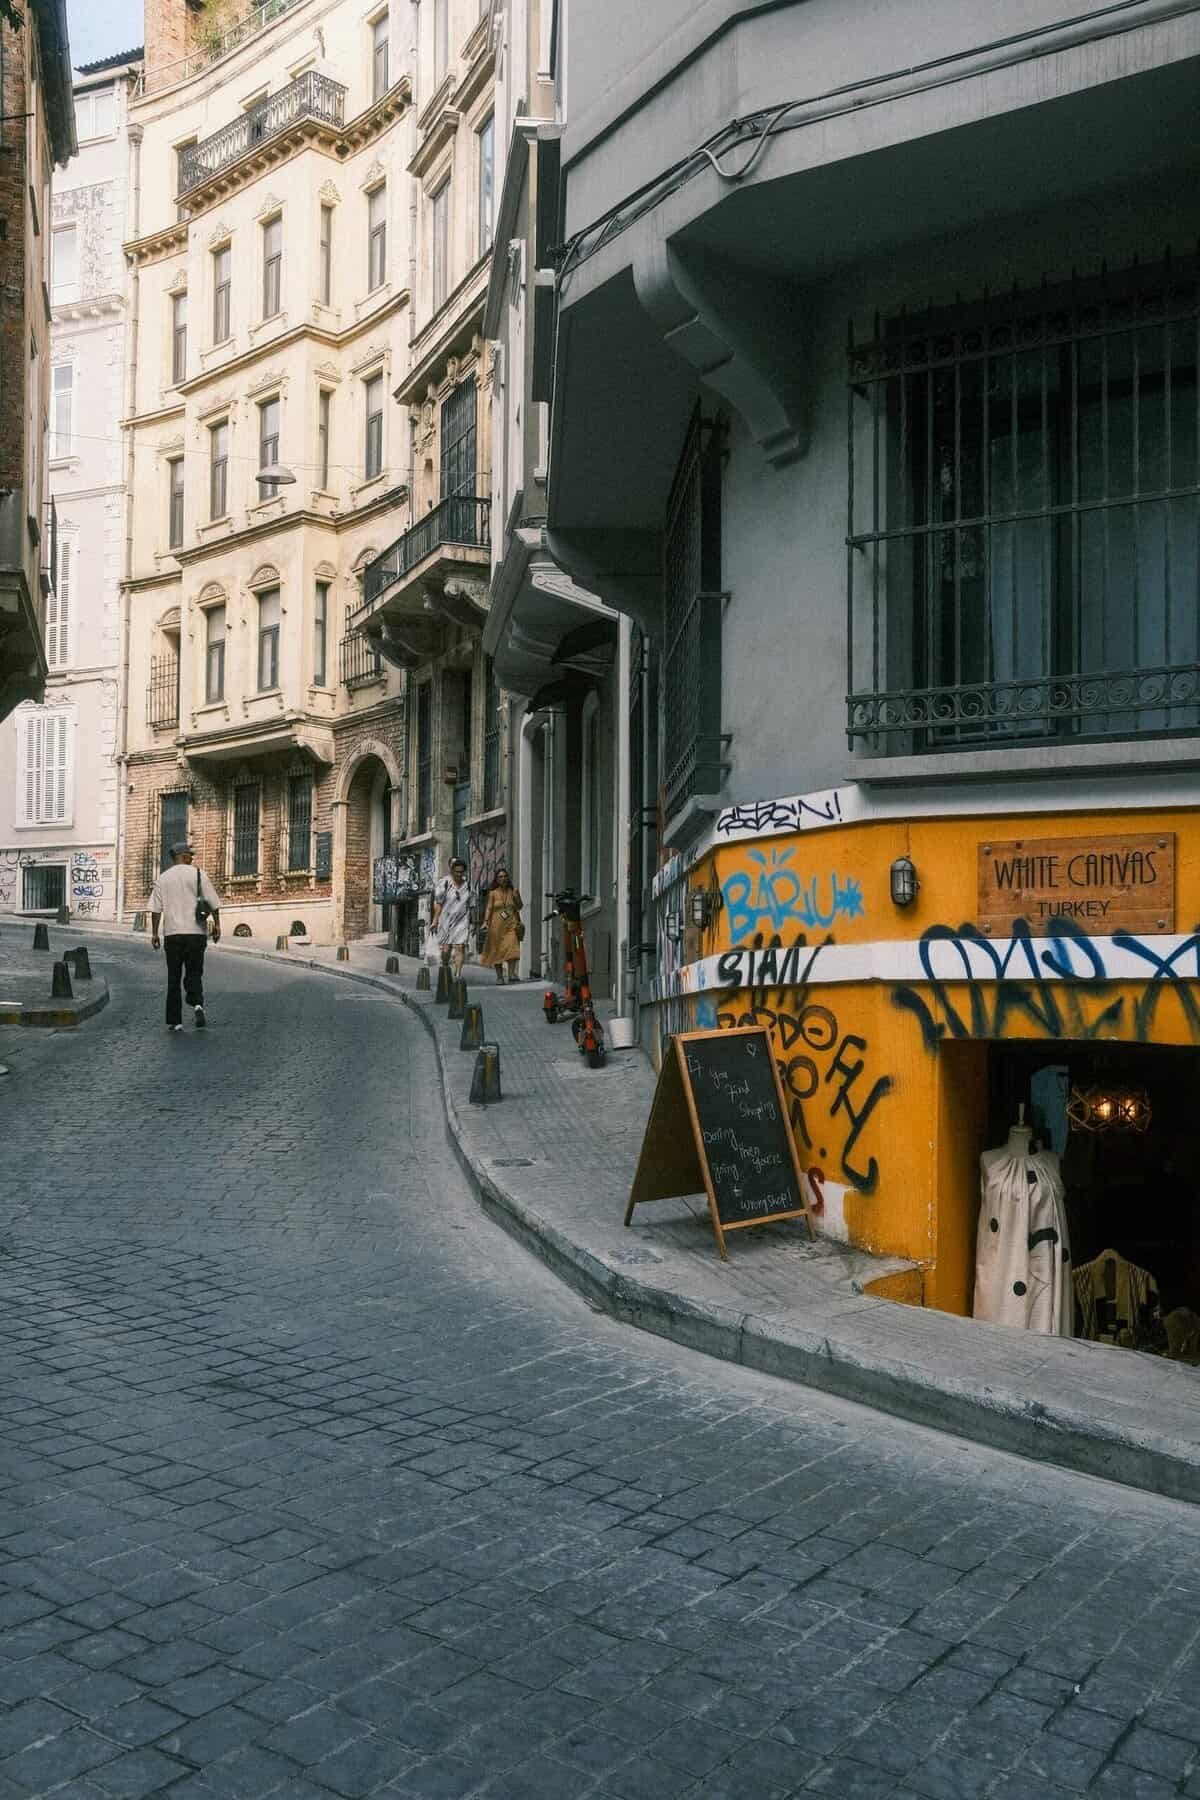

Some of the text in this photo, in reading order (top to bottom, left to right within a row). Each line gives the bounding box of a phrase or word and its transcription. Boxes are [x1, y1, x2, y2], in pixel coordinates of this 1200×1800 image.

[994, 851, 1157, 890] WHITE CANVAS
[1037, 900, 1111, 918] TURKEY
